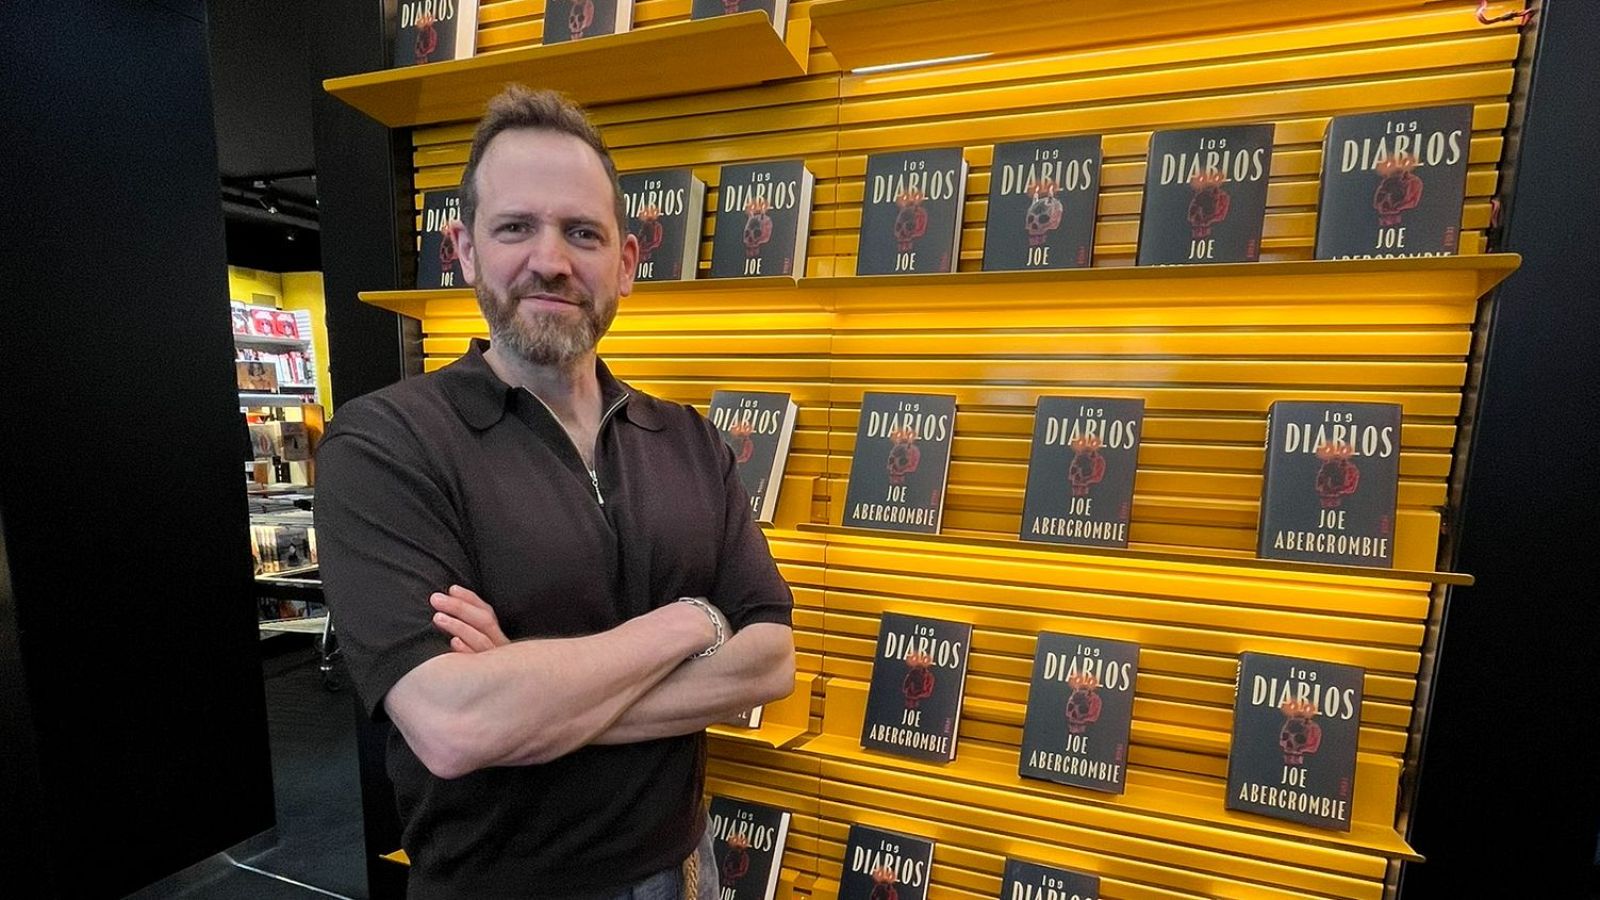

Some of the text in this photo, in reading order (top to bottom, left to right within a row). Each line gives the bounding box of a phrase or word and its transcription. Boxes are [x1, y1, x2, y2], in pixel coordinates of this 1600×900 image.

[401, 0, 454, 29] DIABLOS
[1386, 120, 1418, 134] los
[1199, 137, 1227, 150] los
[1341, 130, 1462, 173] DIABLOS
[903, 159, 925, 171] los
[1035, 148, 1059, 161] los
[751, 171, 771, 182] los
[1000, 158, 1093, 196] DIABLOS
[1160, 148, 1265, 185] DIABLOS
[644, 179, 662, 191] los
[872, 169, 955, 204] DIABLOS
[724, 180, 797, 213] DIABLOS
[426, 206, 460, 232] DIAB
[1375, 227, 1406, 249] JOE
[1026, 246, 1050, 266] JOE
[1188, 239, 1215, 260] JOE
[637, 262, 654, 279] JOE
[743, 257, 762, 276] JOE
[895, 252, 917, 271] JOE
[440, 272, 454, 287] JOE
[740, 398, 759, 409] los
[898, 400, 920, 411] los
[1080, 405, 1104, 418] los
[713, 407, 781, 436] DIABLOS
[867, 410, 948, 442] DIABLOS
[1324, 410, 1353, 423] los
[1044, 416, 1137, 450] DIABLOS
[1284, 422, 1393, 458] DIABLOS
[886, 485, 908, 503] JOE
[852, 503, 936, 527] ABERCROMBIE
[1069, 497, 1093, 516] JOE
[1031, 516, 1126, 542] ABERCROMBIE
[1318, 509, 1346, 530] JOE
[1274, 530, 1388, 558] ABERCROMBIE
[914, 623, 935, 637] los
[884, 631, 962, 669] DIABLOS
[1077, 644, 1101, 657] los
[1043, 652, 1132, 691] DIABLOS
[1290, 667, 1317, 681] los
[1252, 674, 1355, 720] DIABLOS
[901, 708, 922, 728] JOE
[869, 723, 949, 754] ABERCROMBIE
[1065, 733, 1089, 754] JOE
[1029, 750, 1121, 783] ABERCROMBIE
[1281, 765, 1308, 788] JOE
[1239, 782, 1347, 821] ABERCROMBIE
[736, 808, 753, 820] los
[712, 814, 774, 852] DIABLOS
[880, 840, 900, 853] los
[852, 845, 924, 888] DIABLOS
[1042, 874, 1064, 890] los
